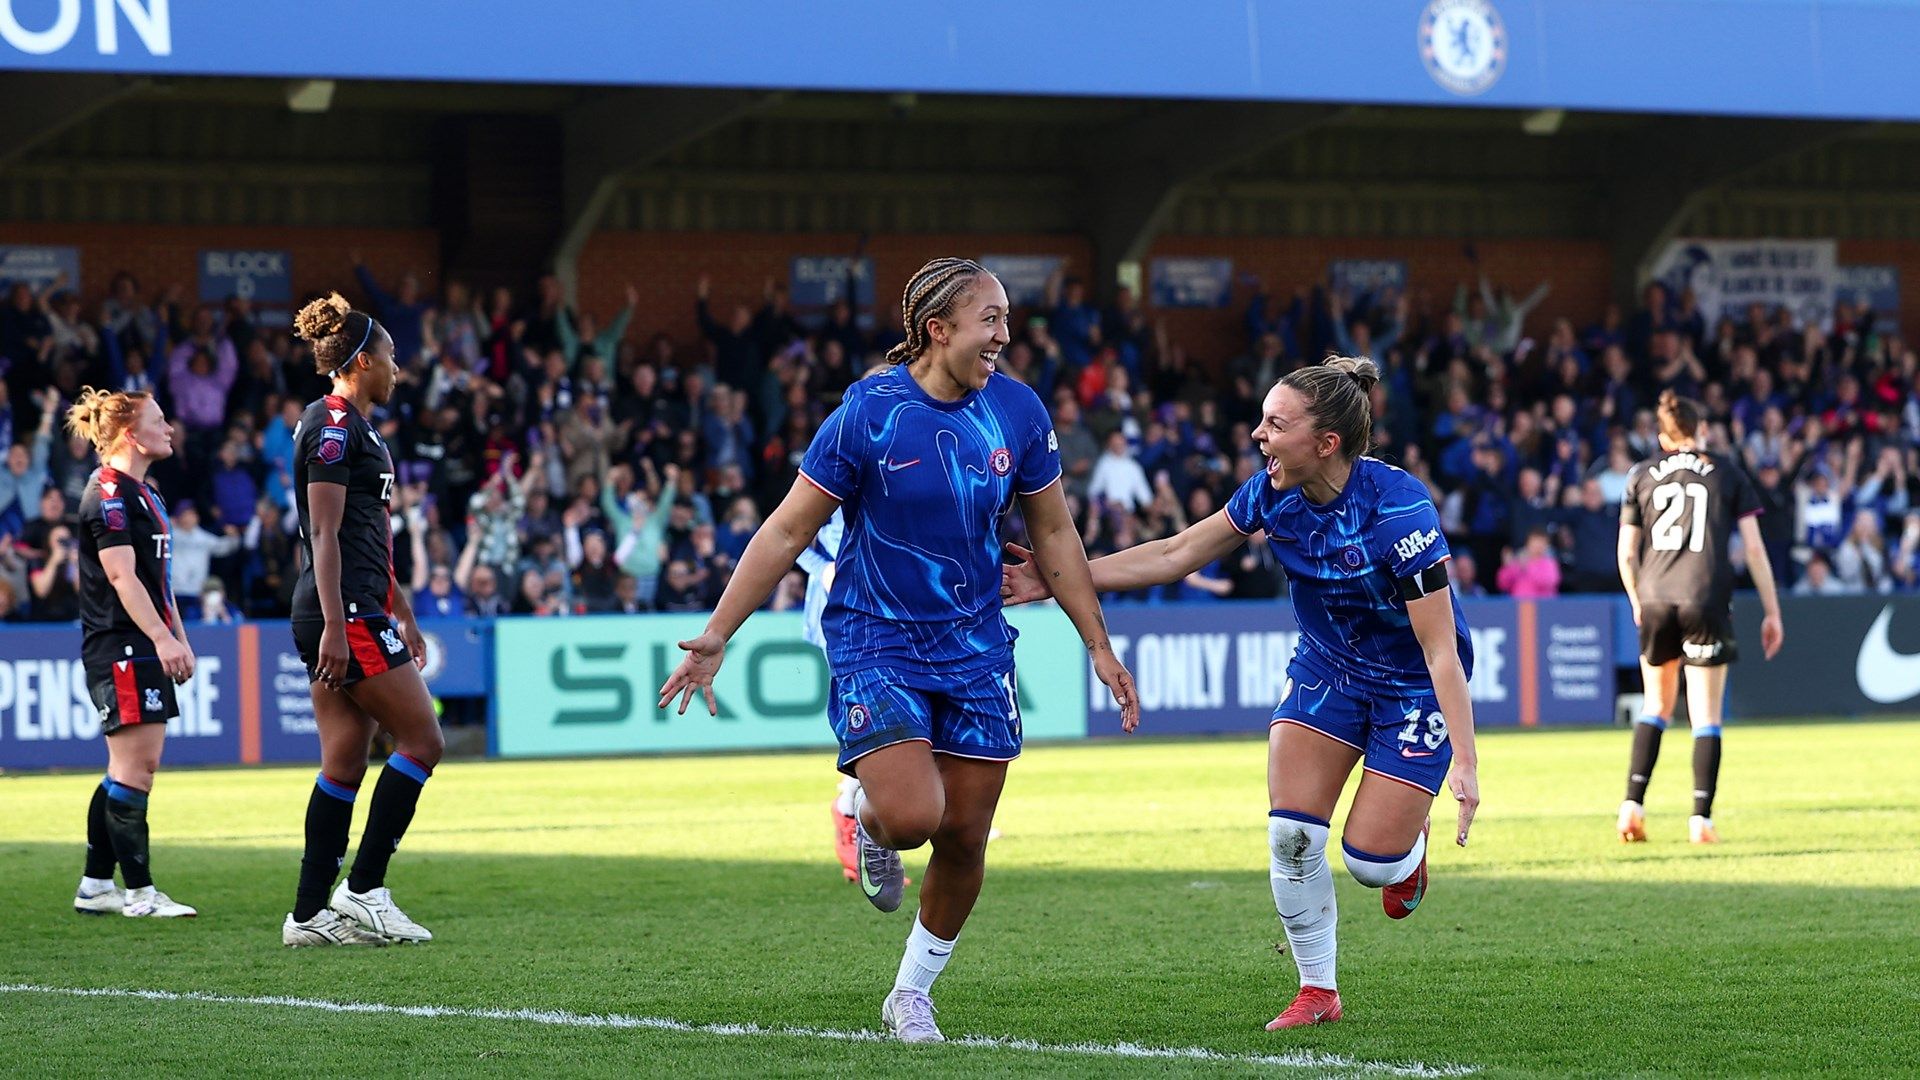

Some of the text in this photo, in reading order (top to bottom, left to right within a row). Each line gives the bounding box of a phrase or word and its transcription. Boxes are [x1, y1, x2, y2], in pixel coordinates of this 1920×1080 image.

[206, 252, 286, 277] BLOCK
[1651, 481, 1709, 553] 21
[1393, 529, 1424, 552] LIVE
[1399, 526, 1440, 562] NATION
[1136, 632, 1231, 711] ONLY
[1397, 708, 1448, 750] 19
